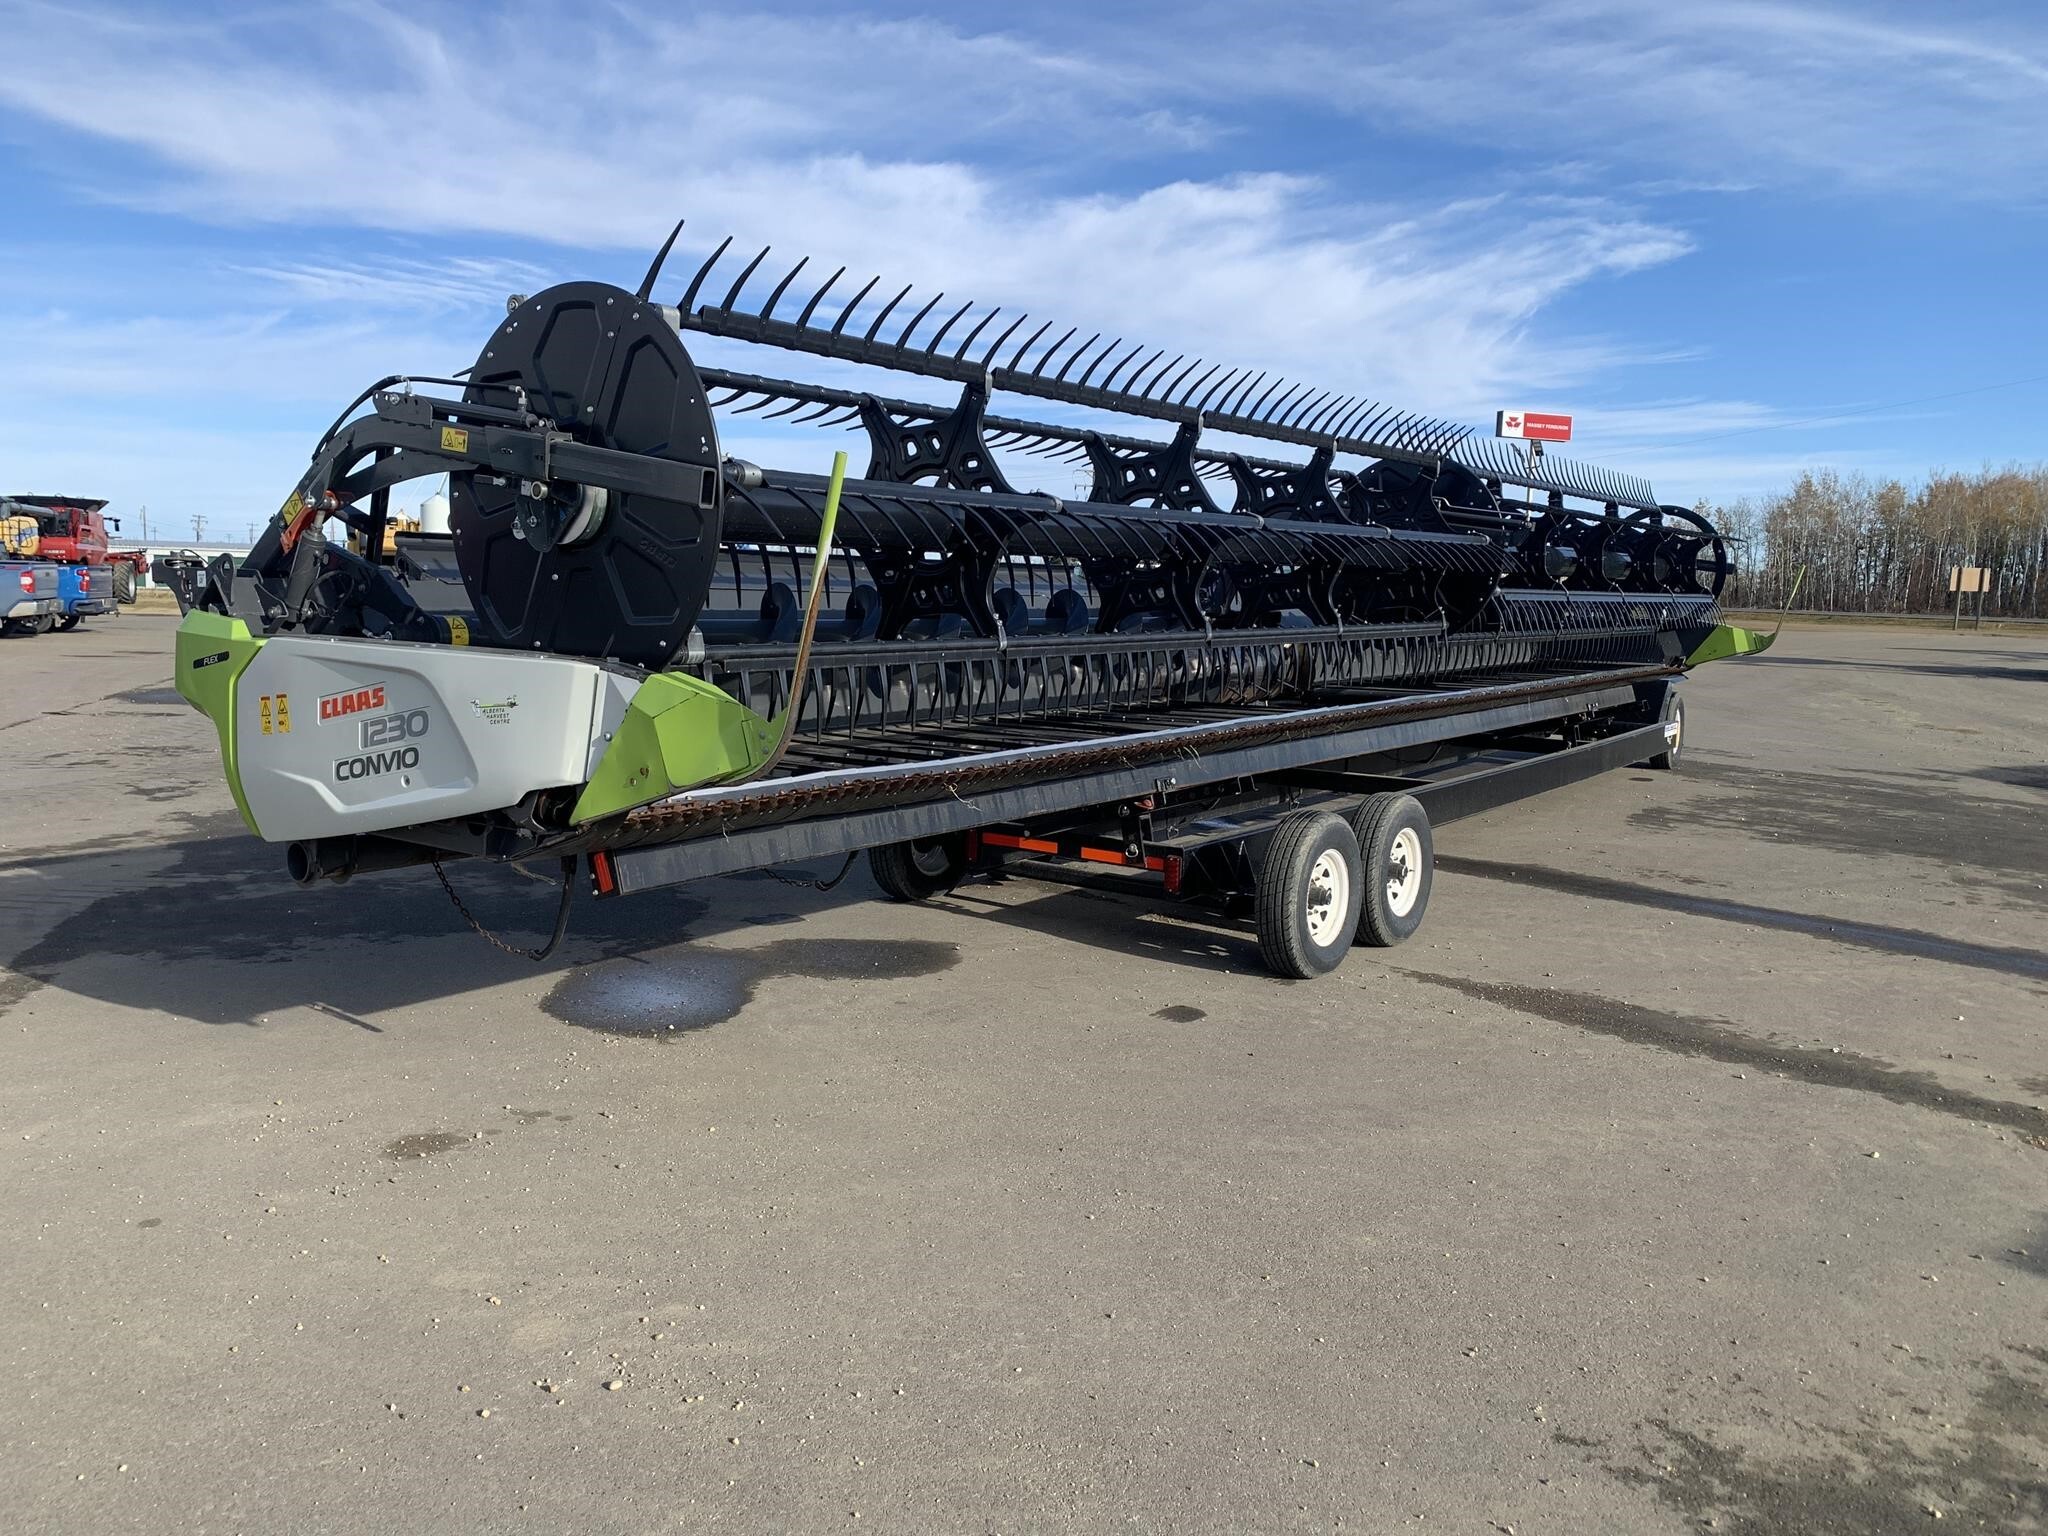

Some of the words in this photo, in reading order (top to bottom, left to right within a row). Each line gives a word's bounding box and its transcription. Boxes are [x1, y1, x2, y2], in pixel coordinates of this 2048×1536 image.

[203, 655, 218, 666] FLEX
[321, 687, 385, 720] CLAAS
[363, 709, 429, 748] 1230
[336, 747, 420, 781] CONVIO
